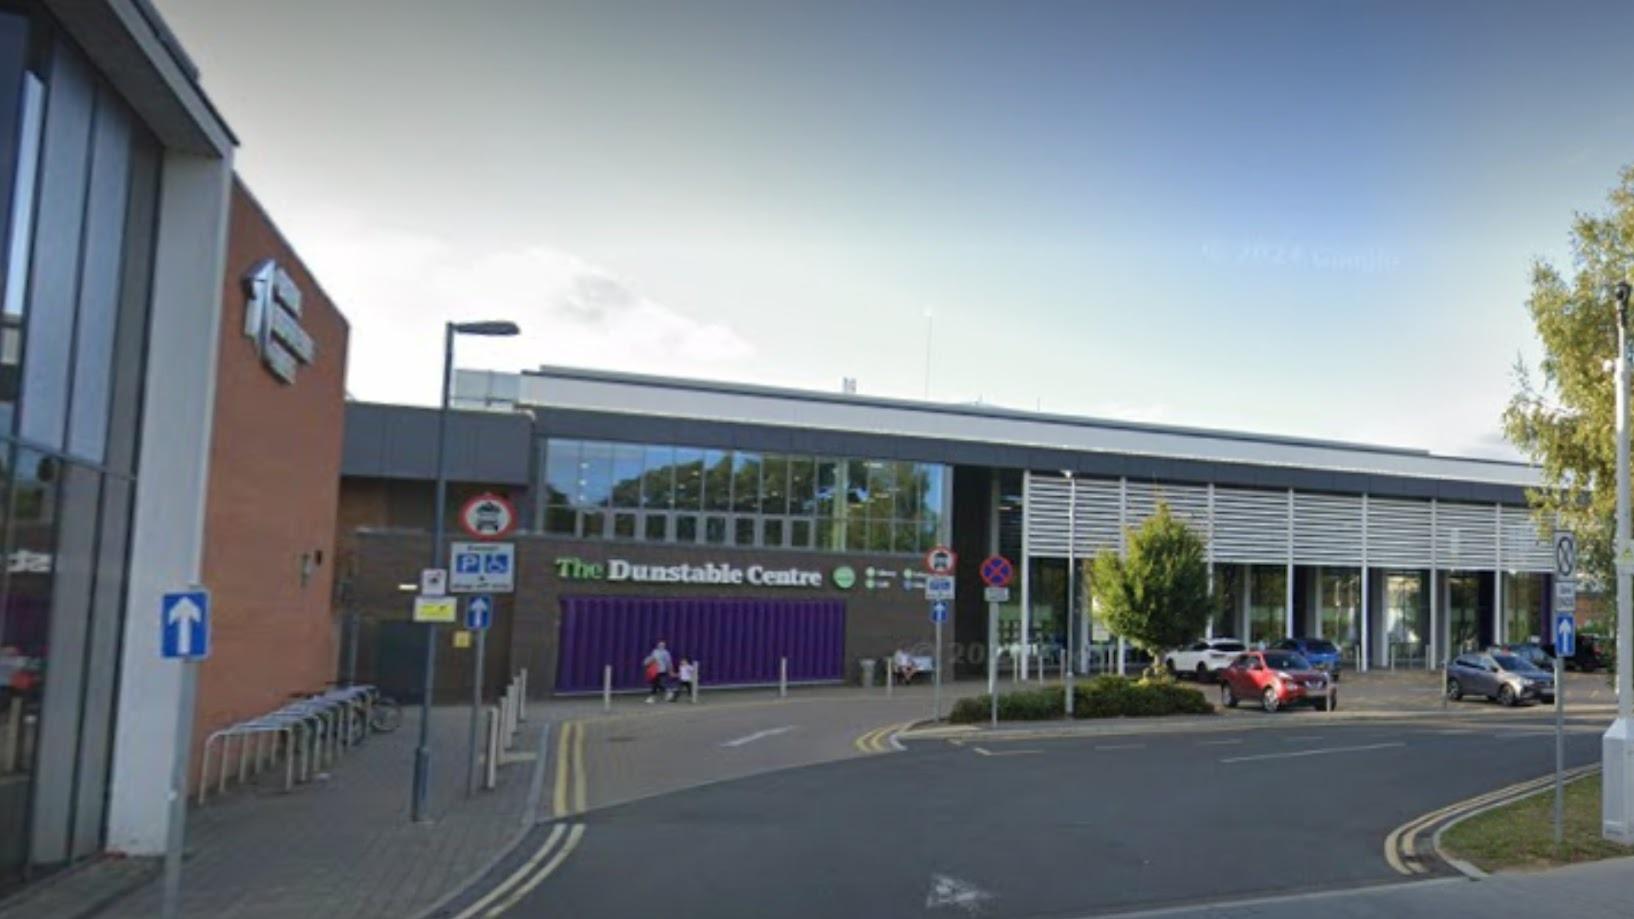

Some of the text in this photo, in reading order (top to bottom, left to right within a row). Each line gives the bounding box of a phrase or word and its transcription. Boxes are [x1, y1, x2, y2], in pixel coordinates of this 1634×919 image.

[555, 557, 823, 588] The Dunstable Centre
